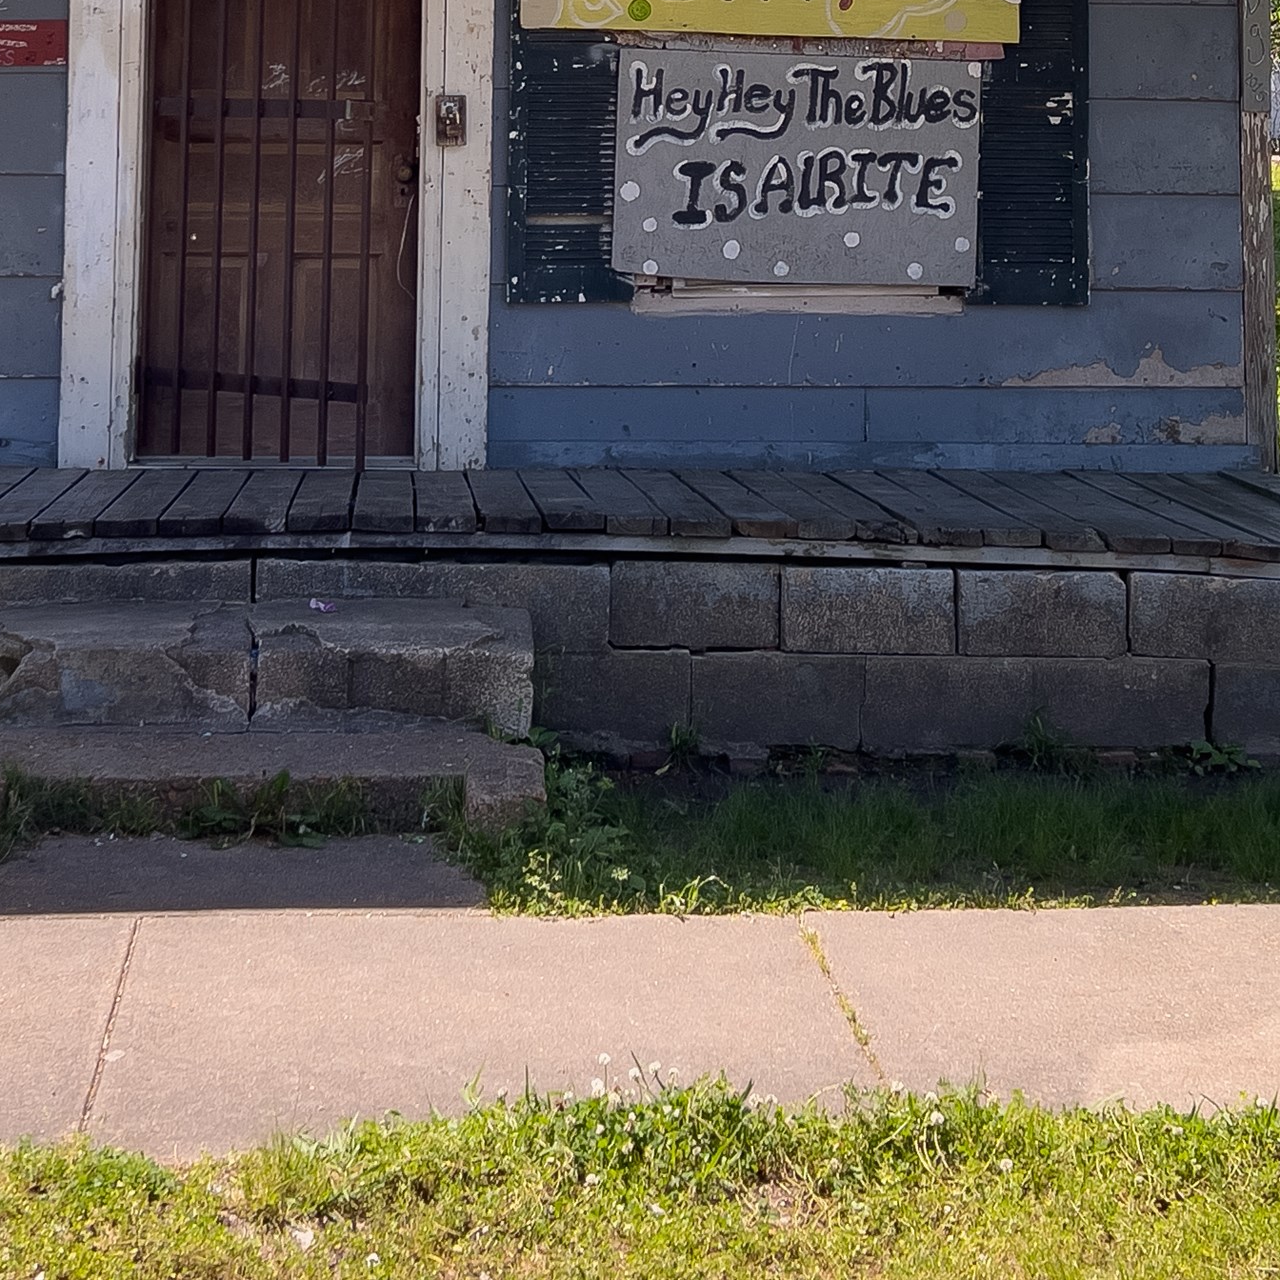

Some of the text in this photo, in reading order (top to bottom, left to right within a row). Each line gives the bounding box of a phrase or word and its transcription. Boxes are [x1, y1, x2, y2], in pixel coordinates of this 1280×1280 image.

[627, 58, 980, 154] Hey Hey The Blues
[672, 158, 748, 228] IS
